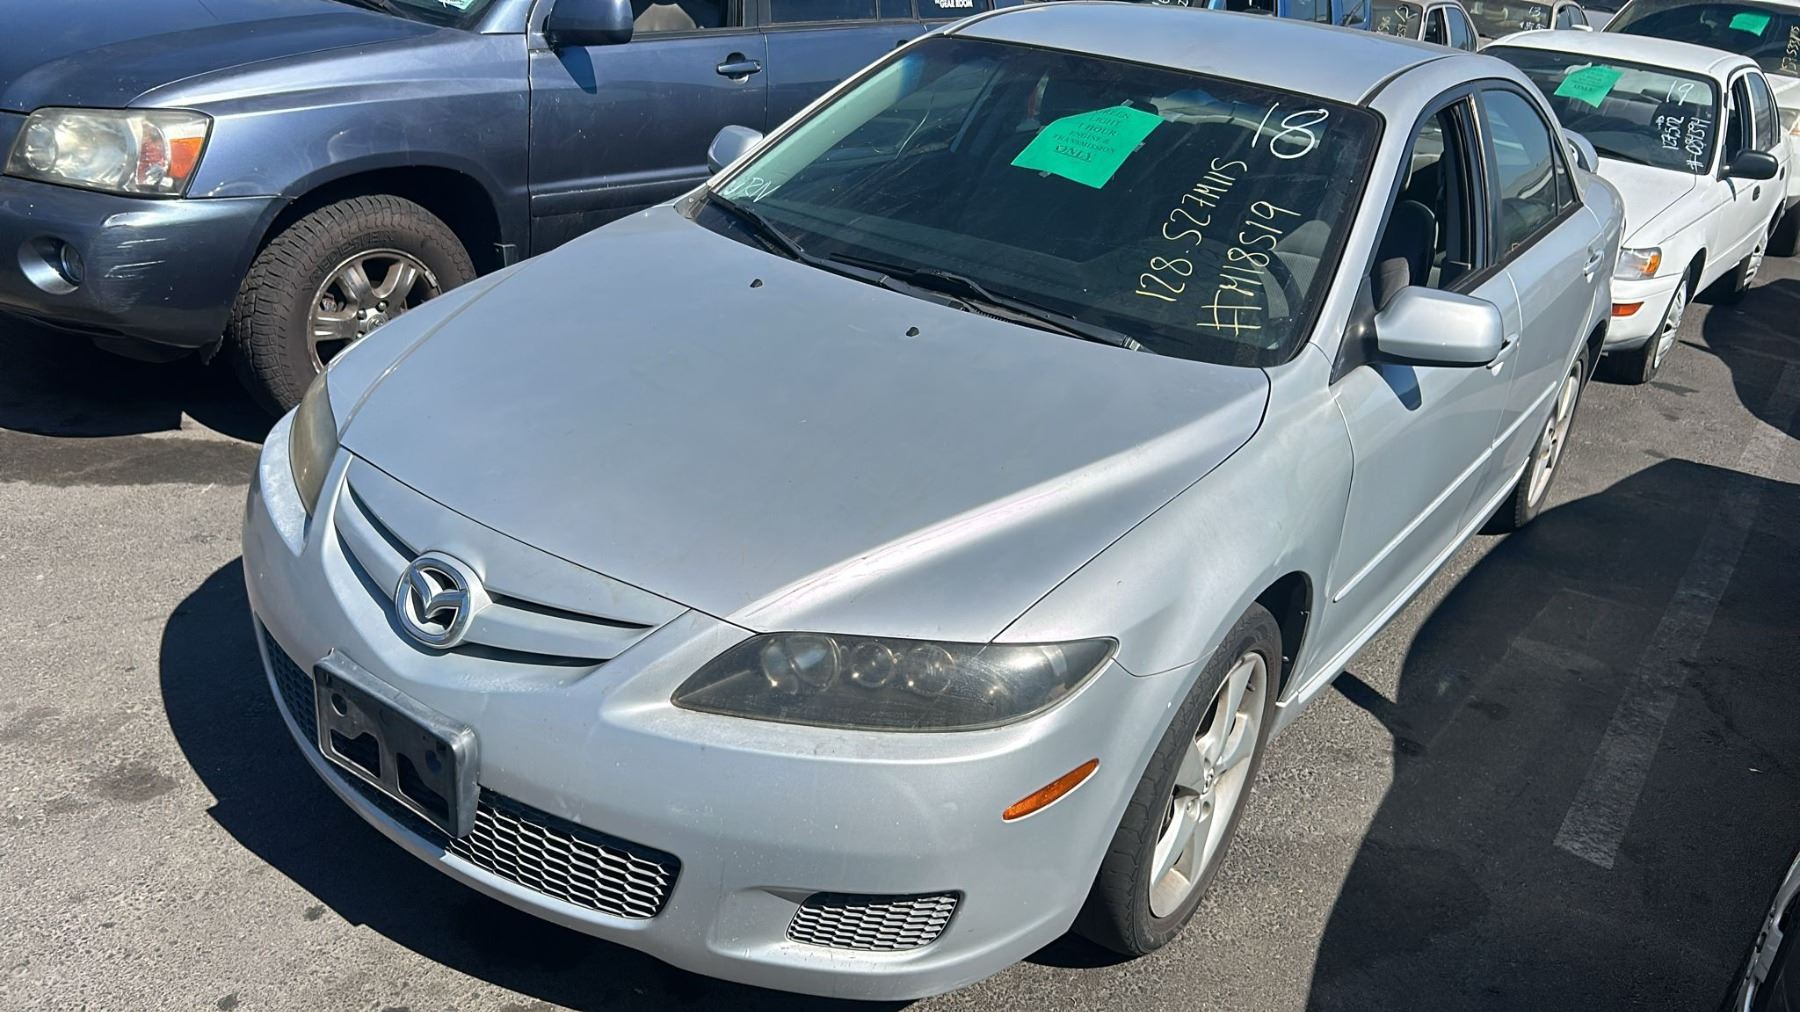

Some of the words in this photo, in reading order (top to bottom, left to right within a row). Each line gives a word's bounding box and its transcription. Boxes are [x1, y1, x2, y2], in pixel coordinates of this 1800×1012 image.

[1666, 80, 1695, 106] 19
[1085, 123, 1119, 137] HOUR
[1250, 102, 1329, 159] 18
[1055, 144, 1093, 162] ONLY
